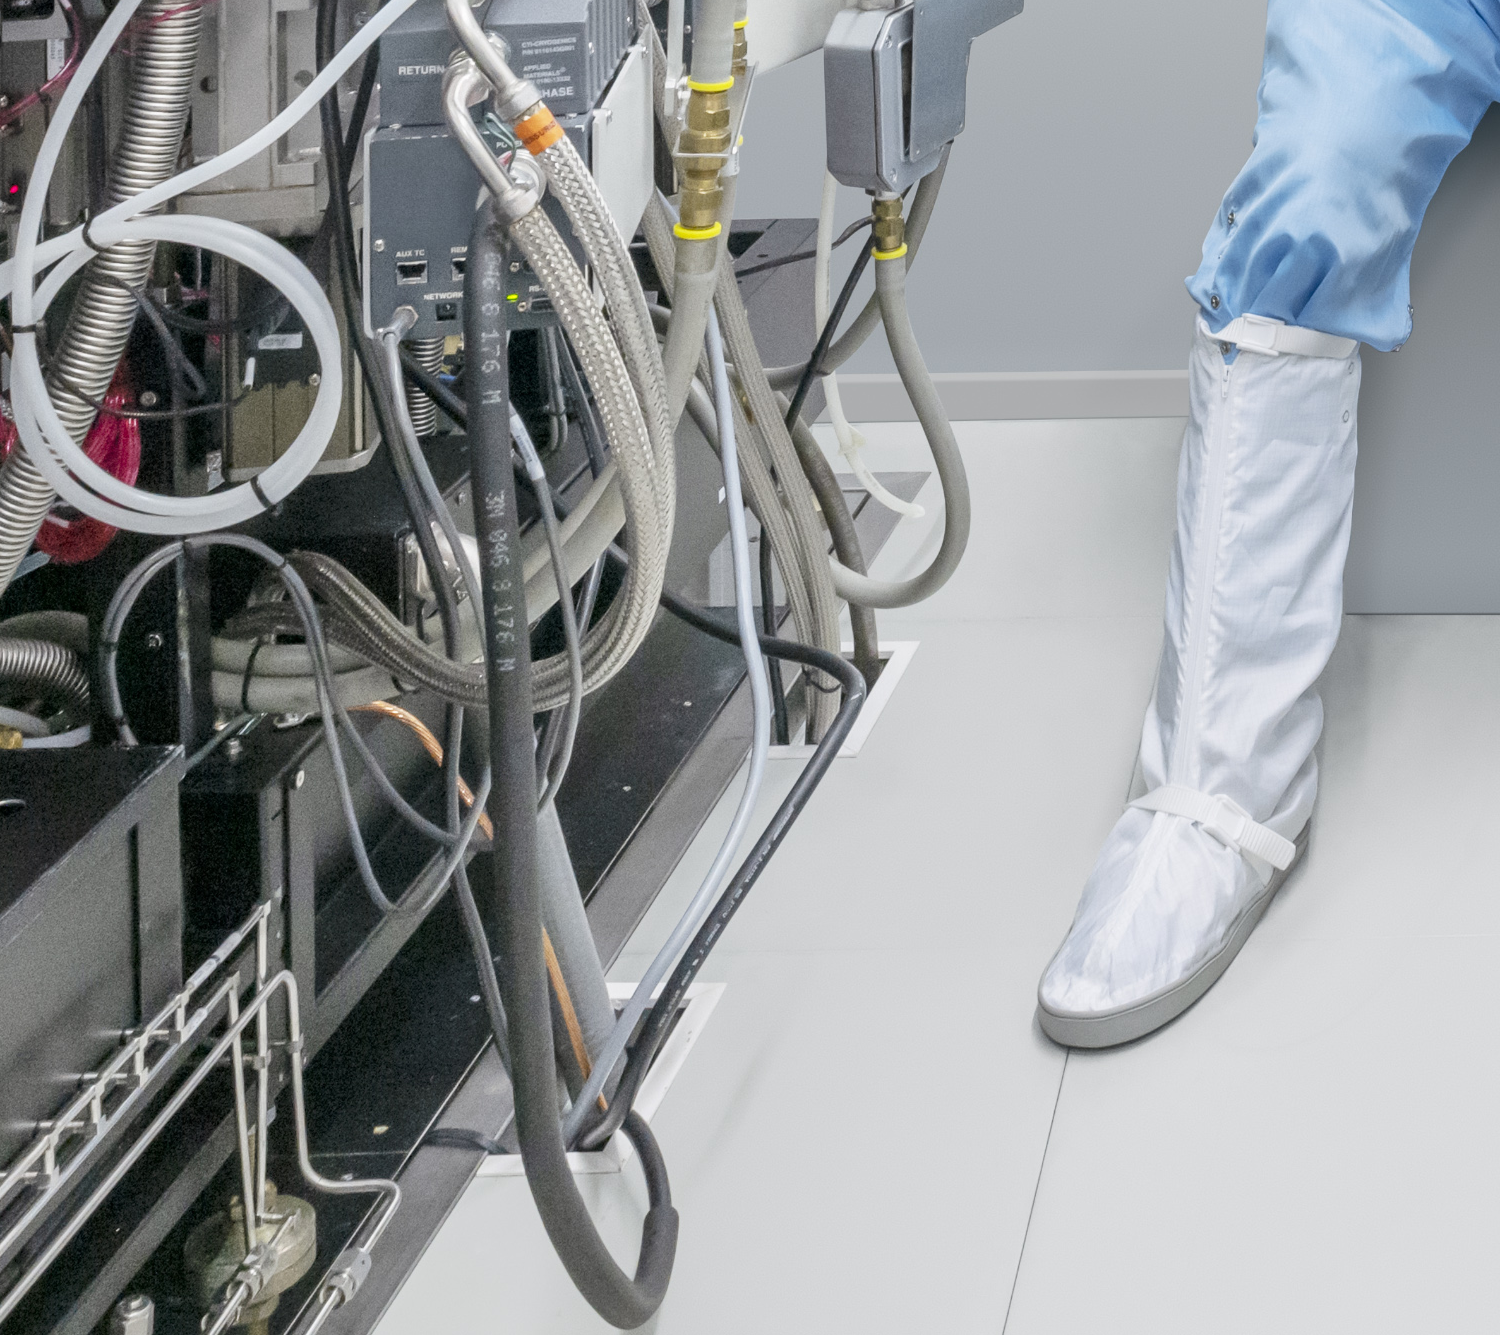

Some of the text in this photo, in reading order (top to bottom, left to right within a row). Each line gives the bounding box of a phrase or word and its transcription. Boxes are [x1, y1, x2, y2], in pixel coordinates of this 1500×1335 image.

[398, 65, 445, 76] RETURN
[541, 86, 574, 98] HASE
[395, 250, 412, 258] AUX
[423, 291, 464, 301] NETWORK
[480, 327, 503, 375] 176
[482, 390, 502, 405] M
[494, 602, 514, 644] 176
[496, 658, 516, 672] M
